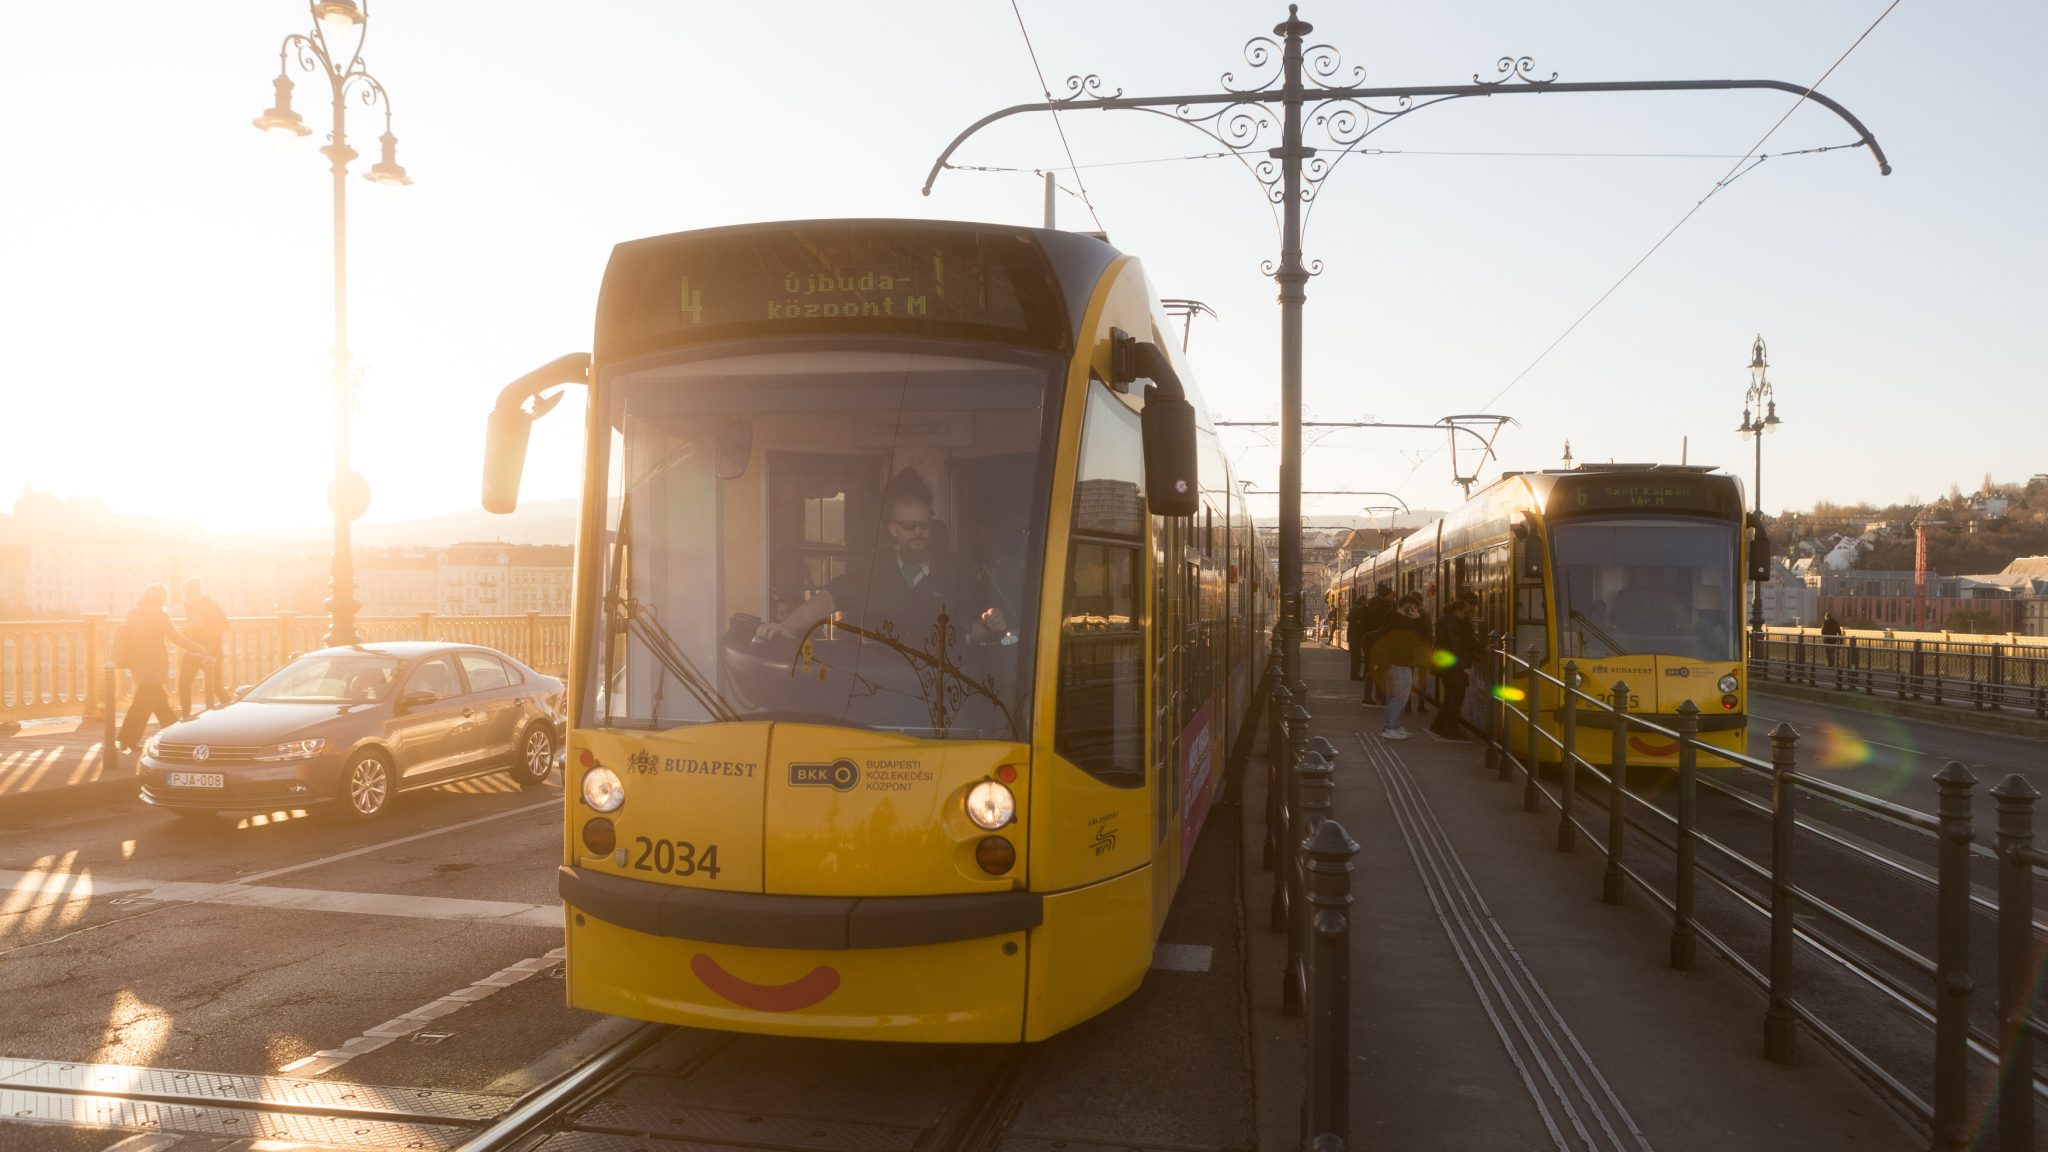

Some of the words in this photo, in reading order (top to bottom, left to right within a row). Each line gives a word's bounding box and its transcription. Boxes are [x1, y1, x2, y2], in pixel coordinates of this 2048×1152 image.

[680, 275, 703, 324] 4
[907, 296, 927, 316] M
[1577, 487, 1588, 506] 6
[664, 758, 757, 777] BUDAPEST
[866, 760, 921, 769] BUDAPESTI
[797, 769, 828, 780] BKK
[866, 770, 933, 781] KÖZLEKEDÉSI
[866, 781, 913, 791] KÖZPONT
[634, 836, 721, 880] 2034
